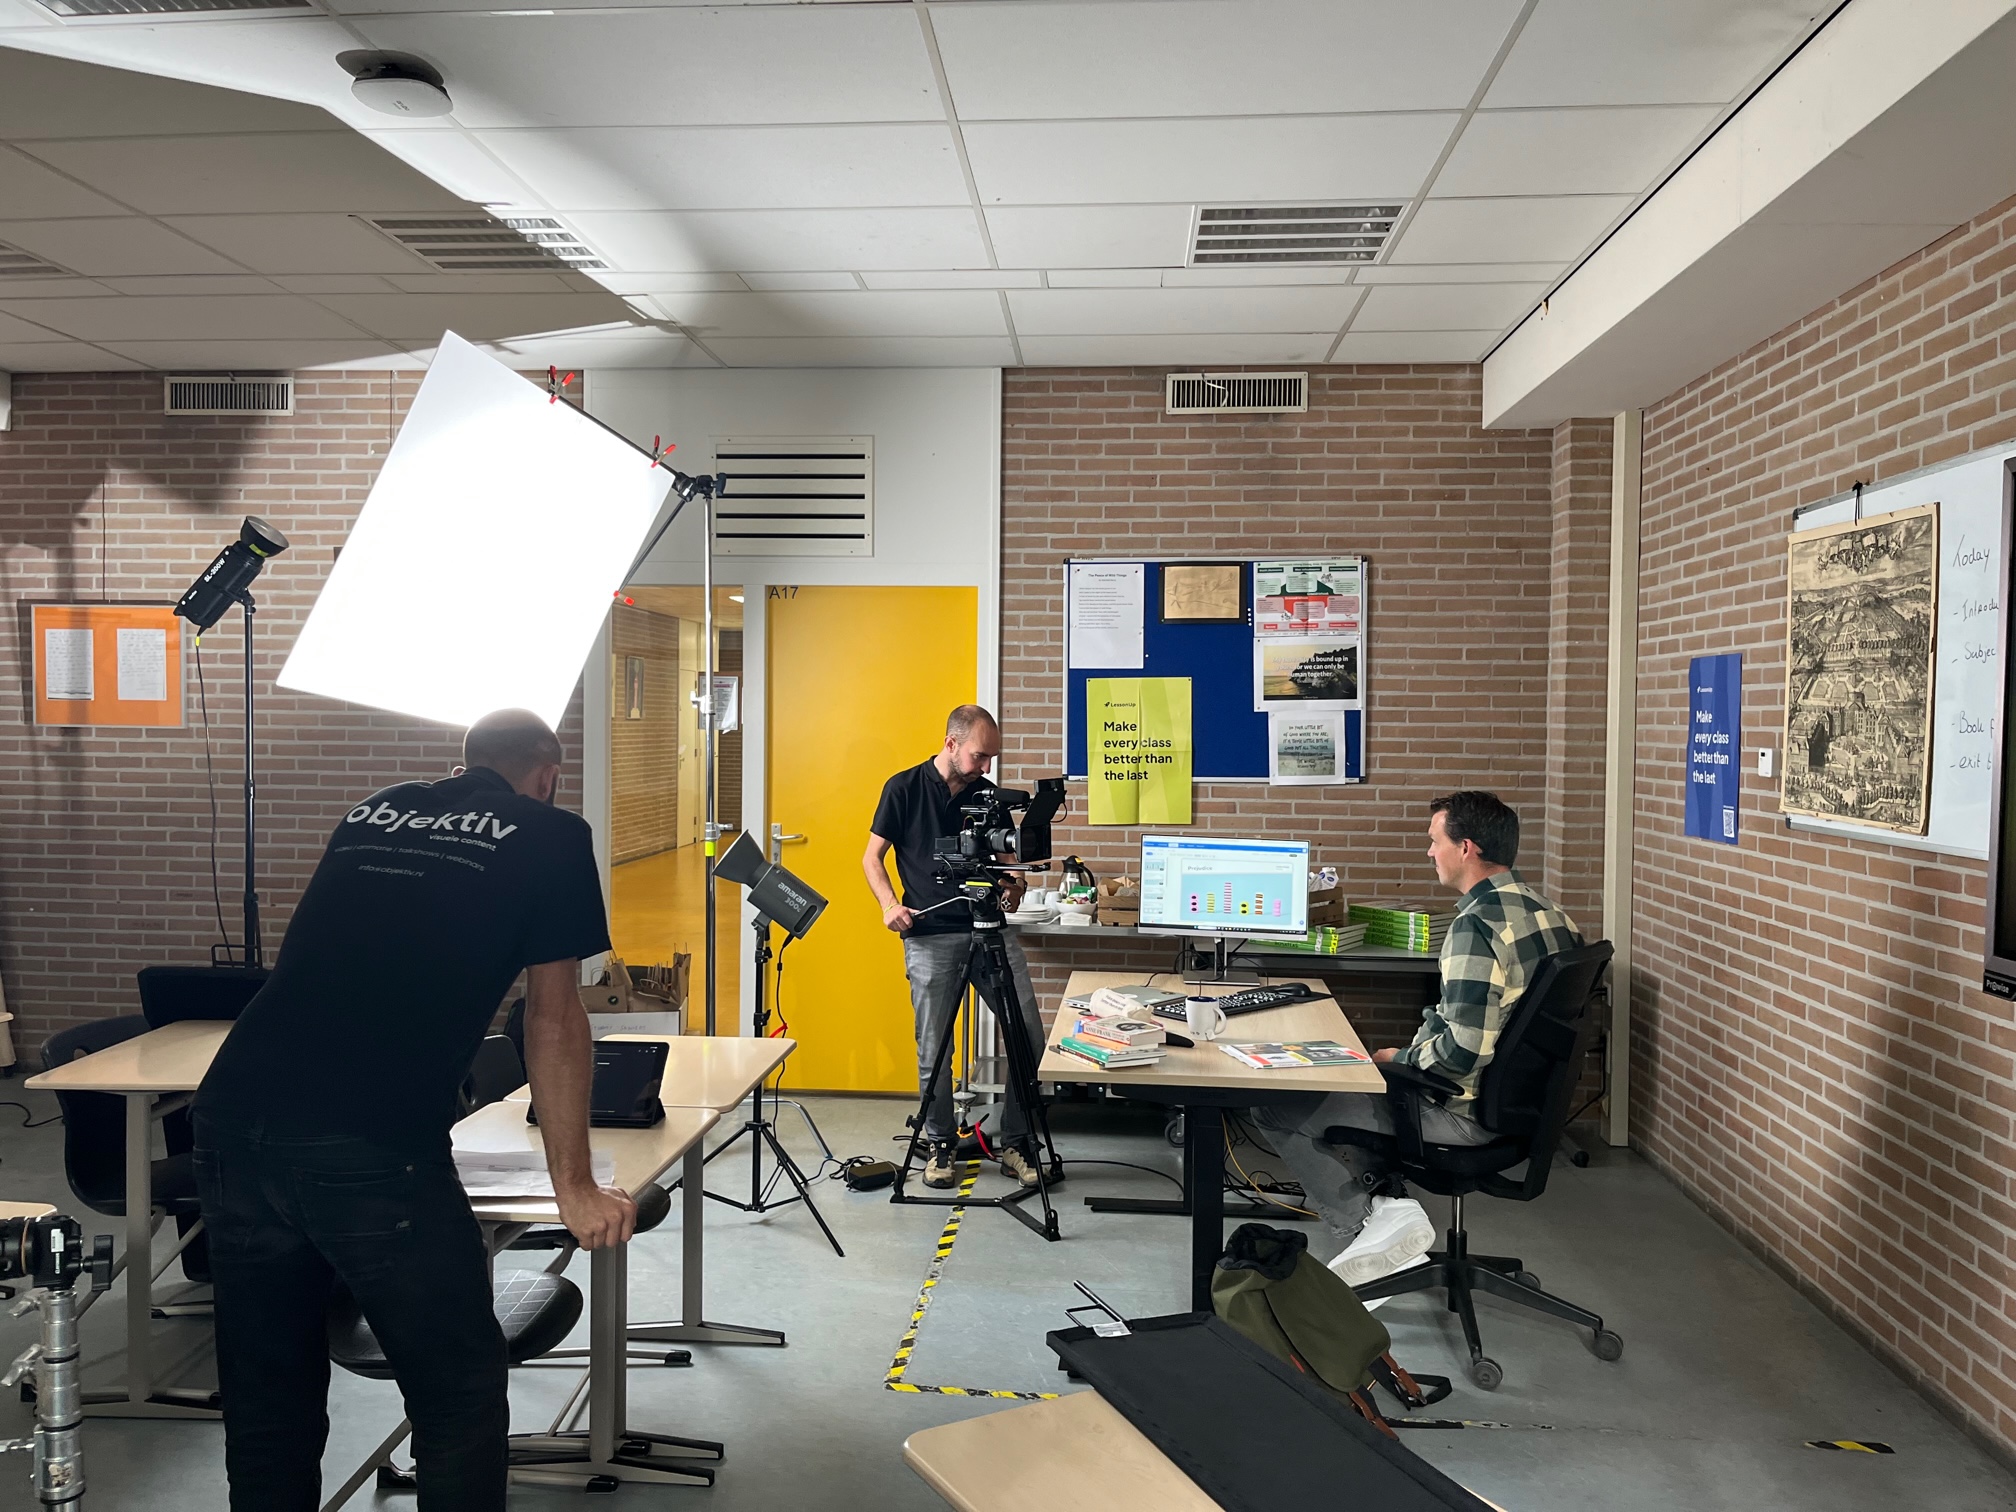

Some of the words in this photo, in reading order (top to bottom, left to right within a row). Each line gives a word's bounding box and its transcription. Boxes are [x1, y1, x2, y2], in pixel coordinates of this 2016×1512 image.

[769, 586, 799, 599] A17
[1696, 710, 1713, 723] Make
[1104, 721, 1137, 732] Make
[1104, 739, 1138, 750] every
[1140, 737, 1172, 748] class
[1694, 732, 1713, 746] every
[1712, 731, 1729, 744] class
[1104, 754, 1142, 764] better
[1145, 753, 1173, 764] than
[1693, 750, 1713, 763] better
[1713, 751, 1729, 765] than
[1104, 770, 1124, 780] the
[1127, 769, 1148, 780] last
[1692, 769, 1704, 784] the
[1704, 770, 1716, 785] last
[346, 801, 518, 840] objektiv
[429, 833, 460, 842] visuele
[461, 837, 497, 851] content
[398, 847, 440, 858] talkshows
[446, 854, 486, 872] webinars
[777, 881, 808, 907] amaran
